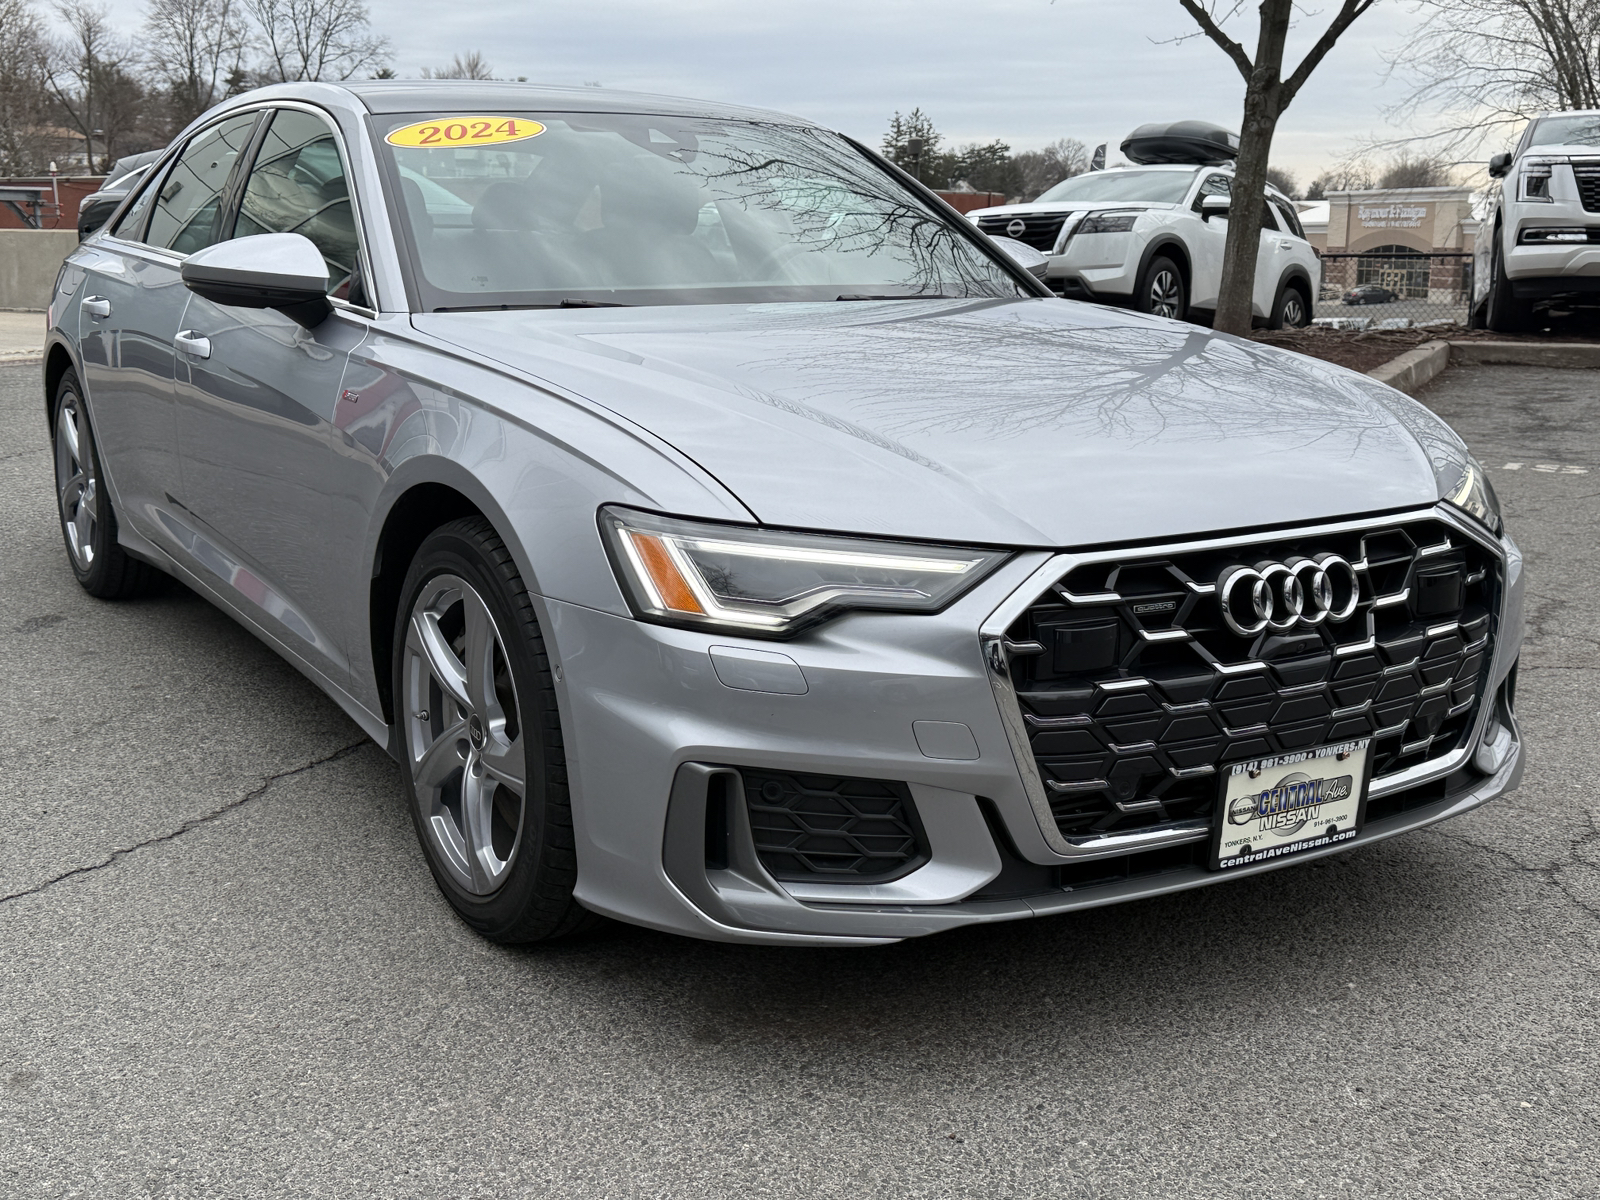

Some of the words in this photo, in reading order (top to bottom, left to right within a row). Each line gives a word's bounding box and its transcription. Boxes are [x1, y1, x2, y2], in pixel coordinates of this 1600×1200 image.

[418, 119, 521, 145] 2024
[1231, 761, 1259, 776] (914)
[1260, 752, 1307, 770] 961-3900
[1232, 804, 1257, 816] NISSAN
[1258, 778, 1324, 818] CENTRAL
[1325, 778, 1348, 801] Ave.
[1259, 804, 1320, 832] NISSAN
[1314, 814, 1348, 828] 914-961-3900
[1220, 829, 1357, 868] CentralAveNissan.com
